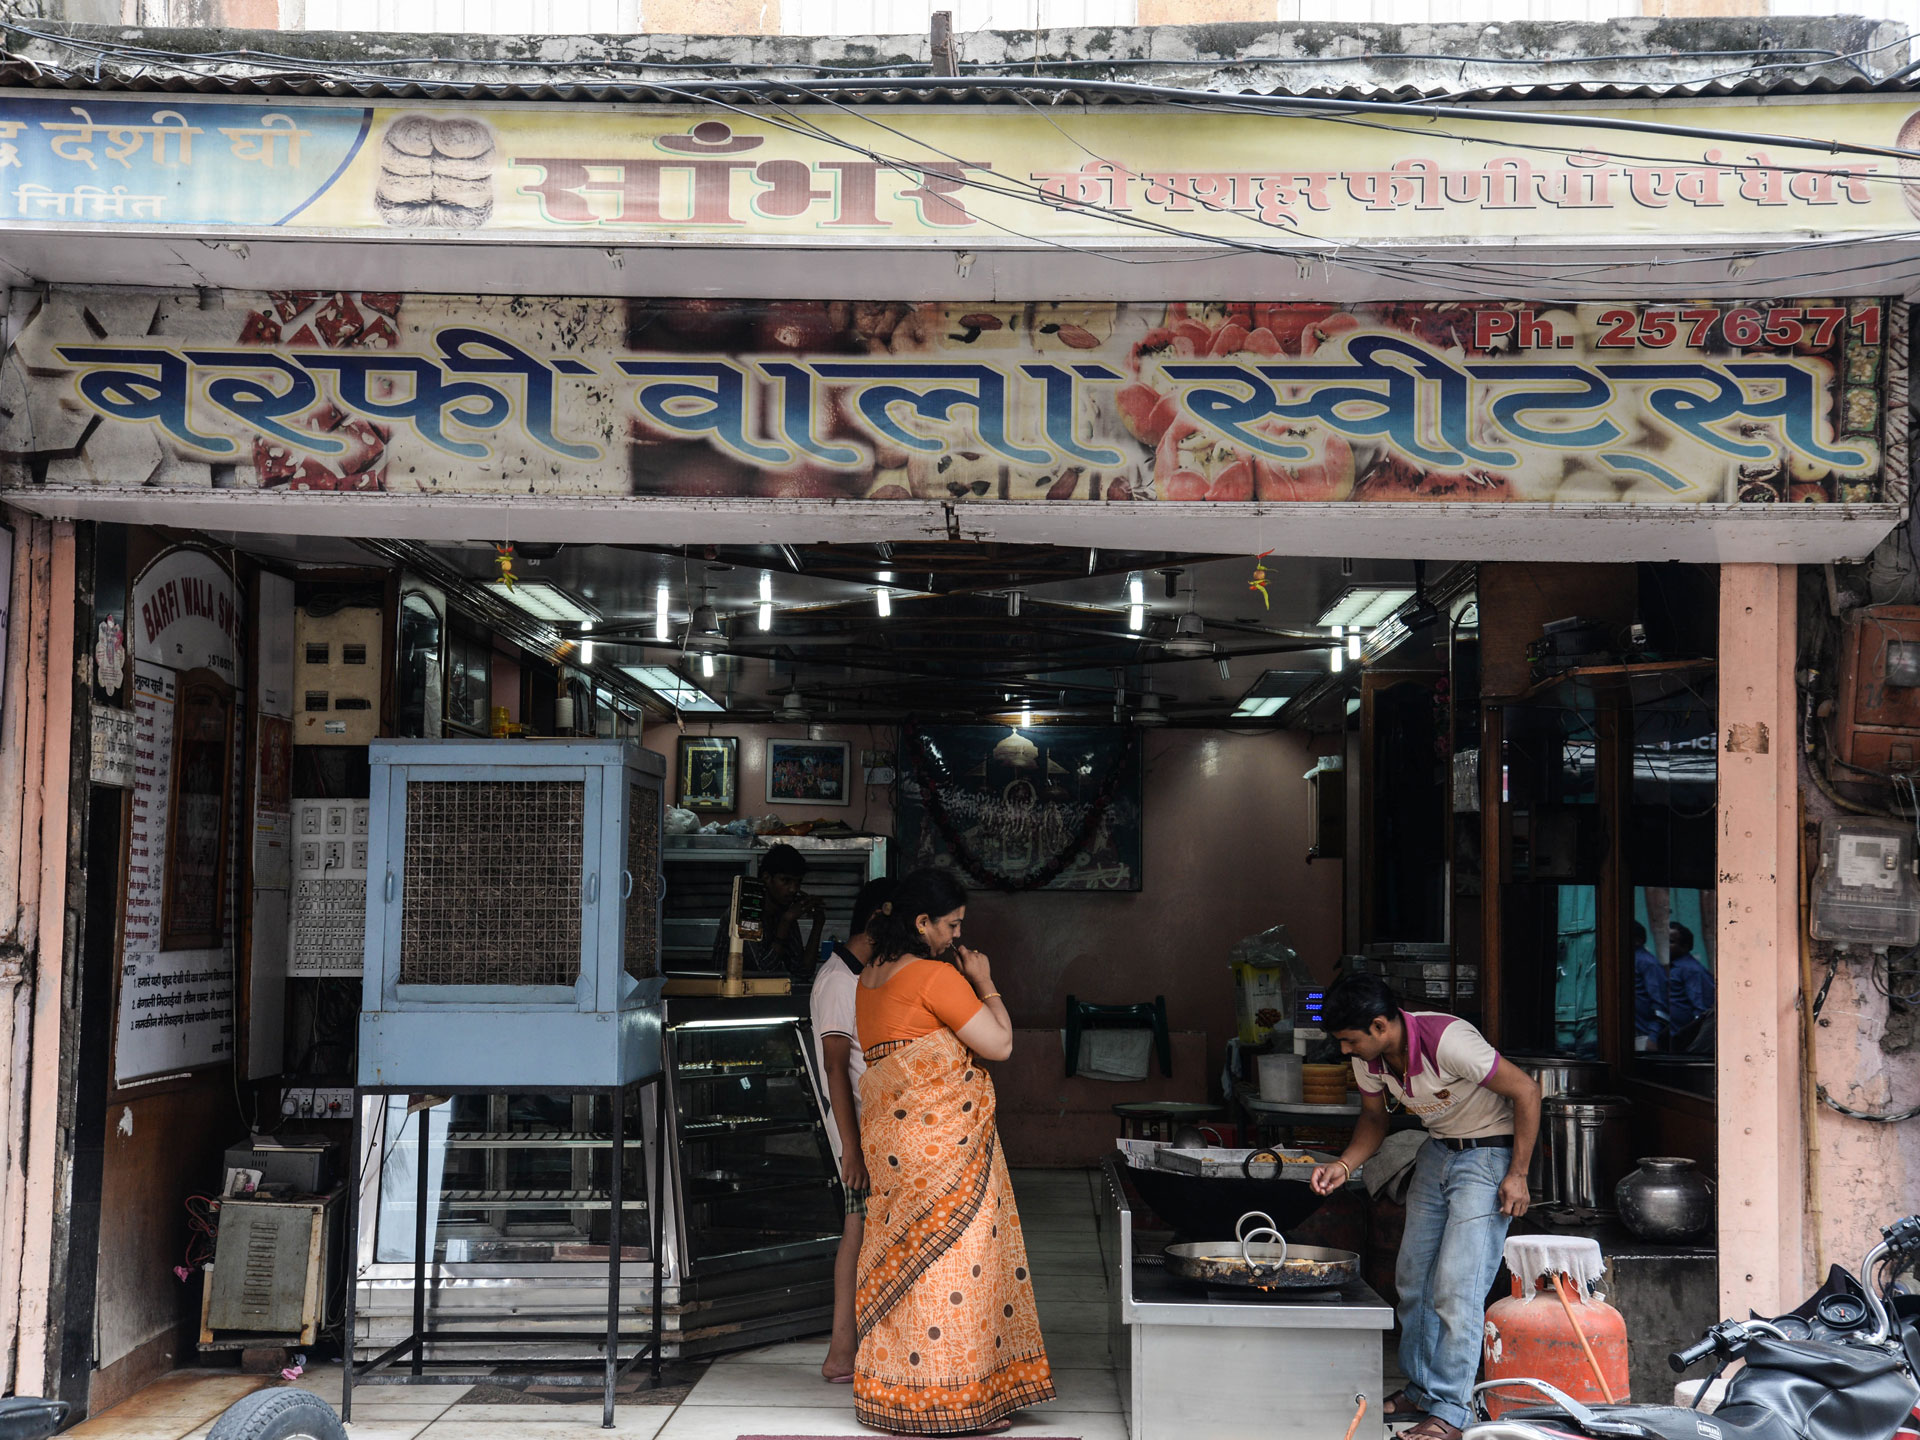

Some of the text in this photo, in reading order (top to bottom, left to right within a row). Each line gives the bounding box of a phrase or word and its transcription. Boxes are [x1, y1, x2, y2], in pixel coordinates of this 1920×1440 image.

[39, 107, 204, 170] देशी
[218, 113, 313, 168] घी
[11, 183, 168, 219] निर्मित
[1030, 159, 1139, 213] की
[1140, 171, 1336, 227] मशहूर
[1624, 149, 1731, 208] एवं
[1734, 151, 1878, 207] घेवर
[1475, 306, 1882, 350] Ph. 2576571
[51, 324, 606, 462] बरफी
[611, 359, 1126, 467] वाला
[142, 580, 180, 644] BARFI
[181, 577, 214, 621] WALA
